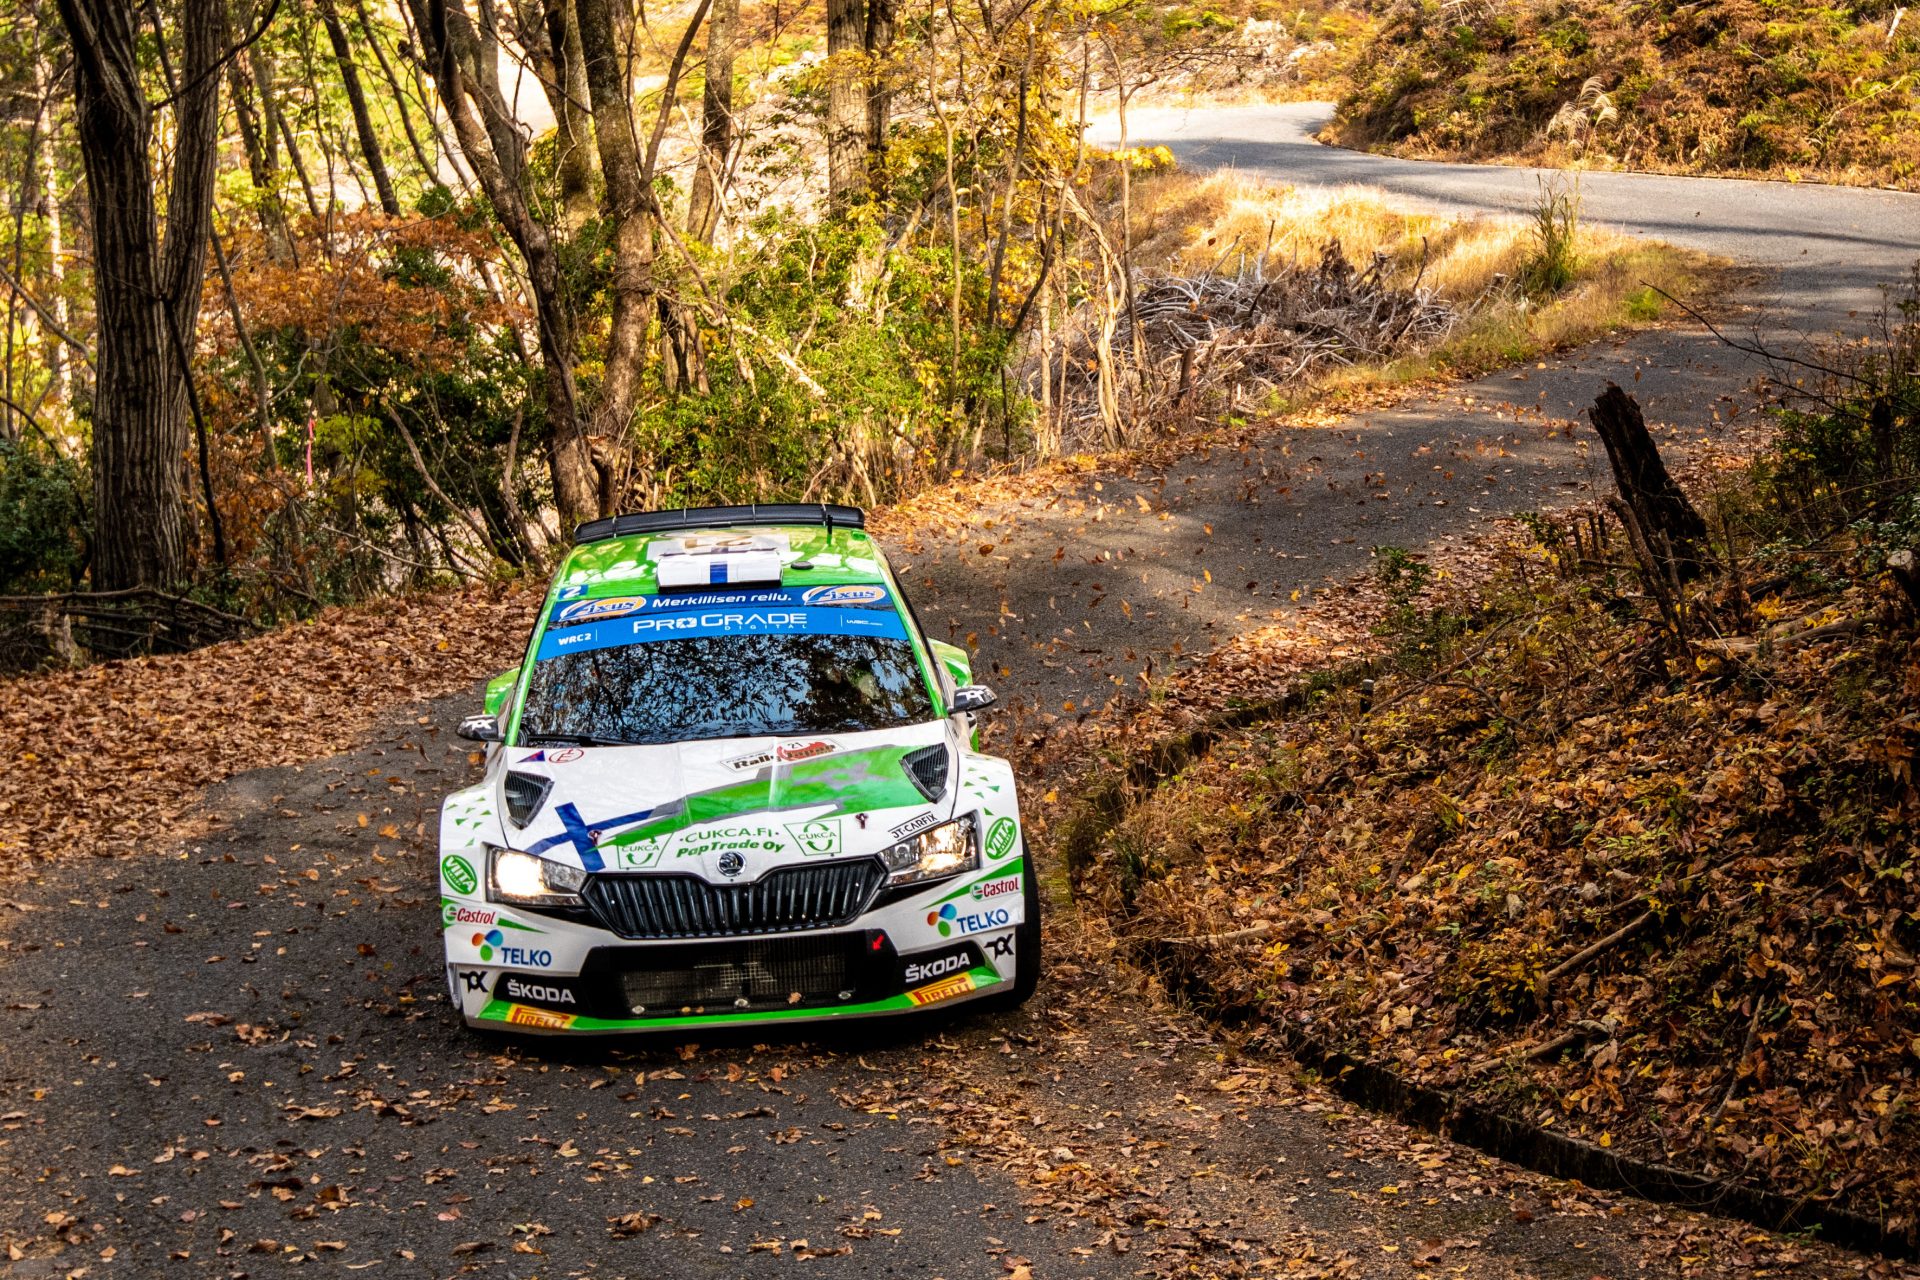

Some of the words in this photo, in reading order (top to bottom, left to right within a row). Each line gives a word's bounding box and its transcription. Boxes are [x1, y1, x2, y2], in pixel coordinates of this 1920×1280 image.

[652, 595, 746, 608] Merkillisen
[724, 623, 808, 631] DIGITAL
[797, 831, 836, 840] CUKCA
[762, 840, 785, 853] Oy
[983, 876, 1020, 898] Castrol
[456, 907, 496, 925] Castrol
[956, 908, 1009, 934] TELKO
[501, 946, 552, 968] TELKO
[905, 951, 970, 983] ŠKODA
[506, 978, 576, 1004] ŠKODA
